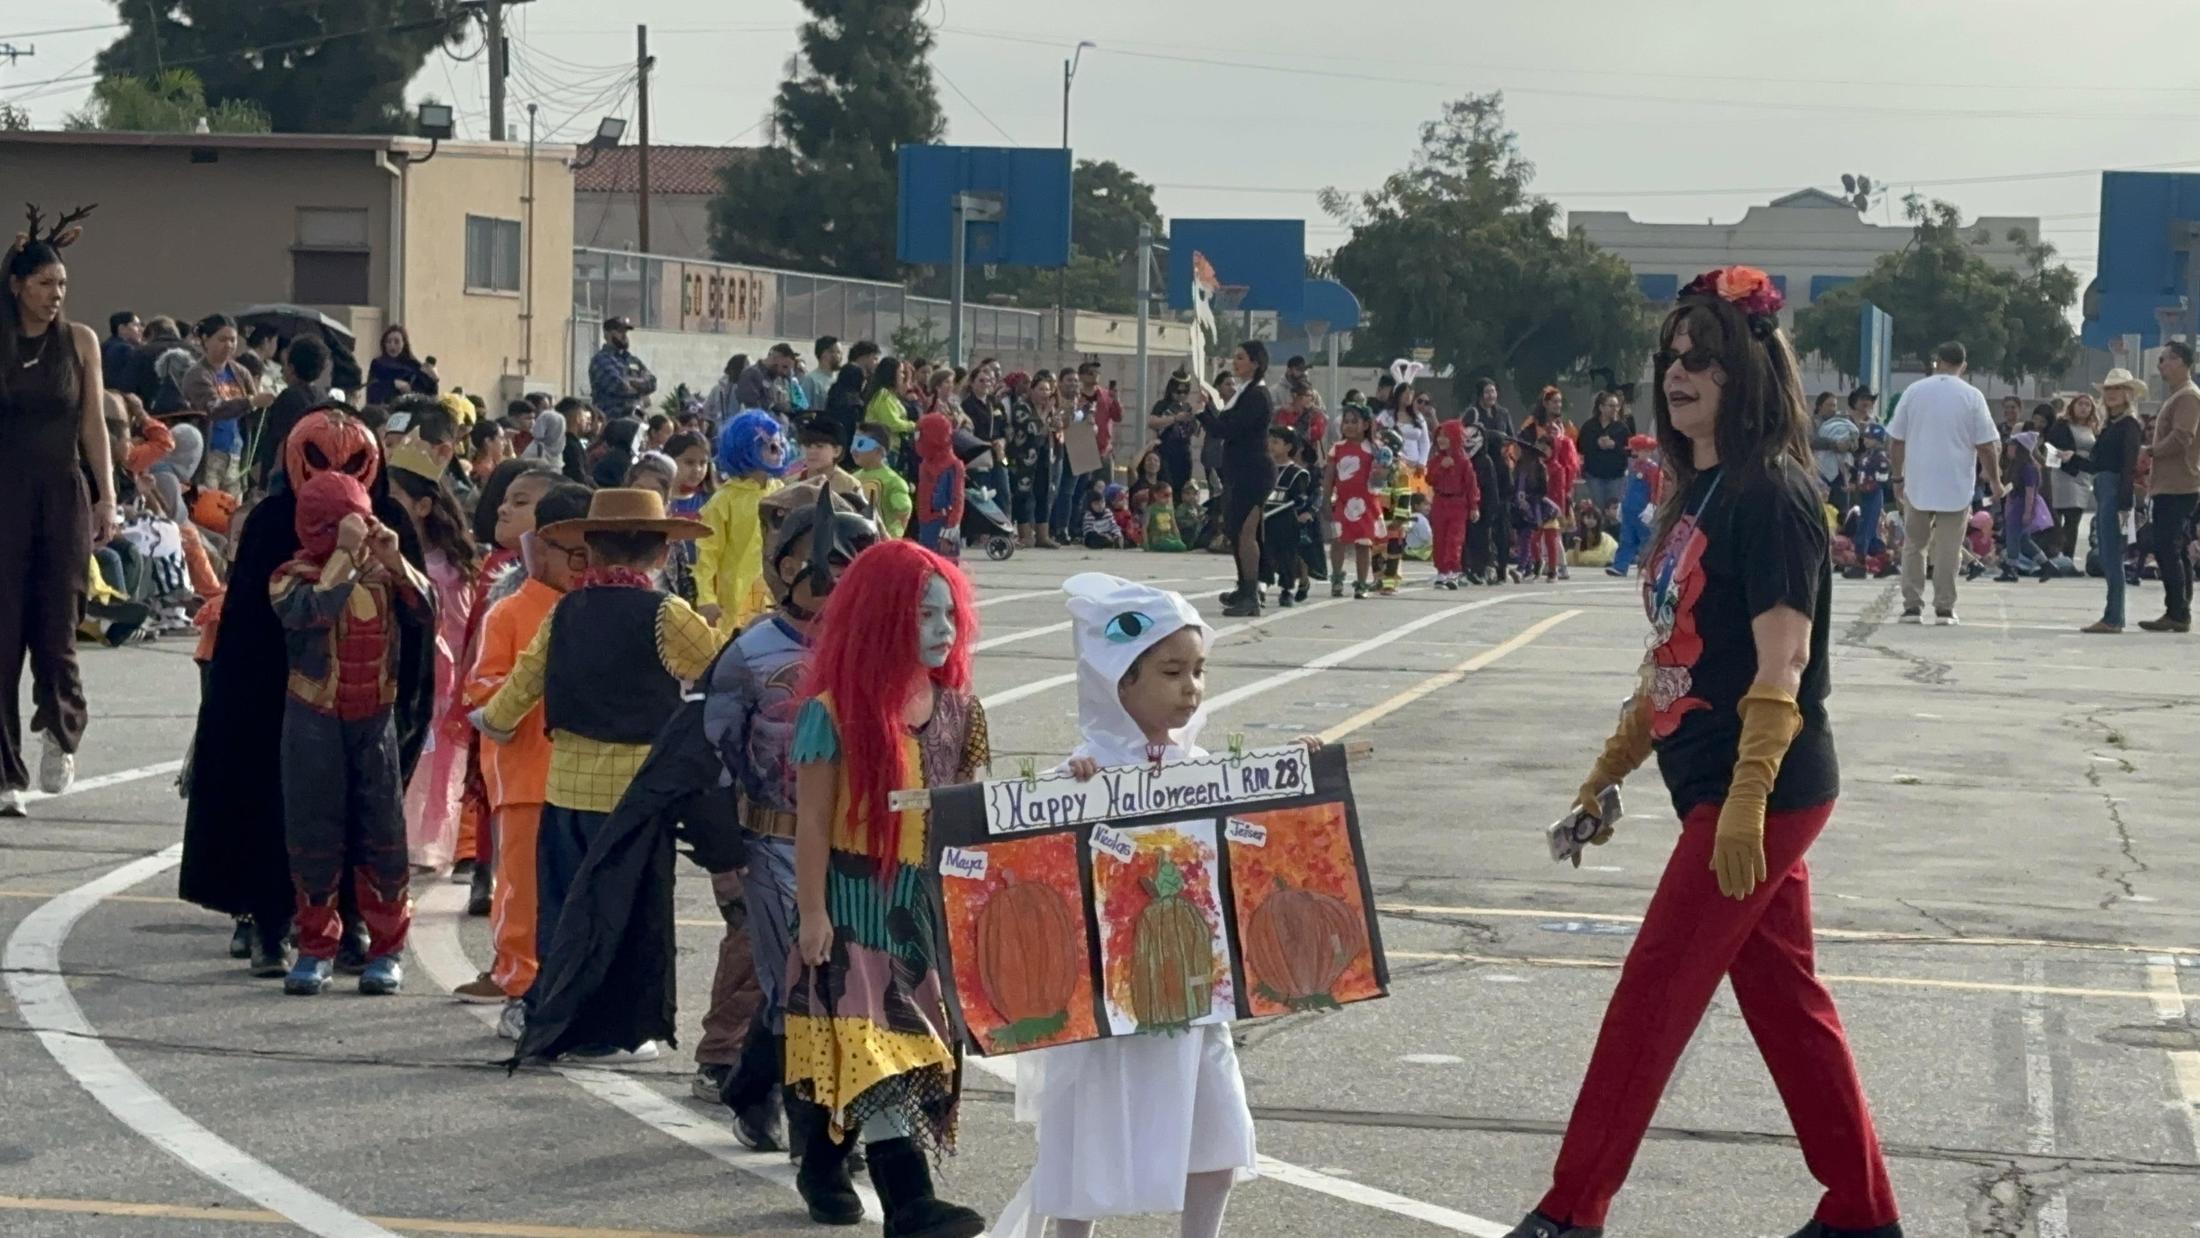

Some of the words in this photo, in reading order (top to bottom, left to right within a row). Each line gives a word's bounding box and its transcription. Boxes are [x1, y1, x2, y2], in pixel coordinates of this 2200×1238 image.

[684, 273, 702, 316] GO
[1005, 783, 1087, 829] Happy
[1102, 763, 1232, 818] Halloween!
[1274, 758, 1300, 790] 28
[1094, 826, 1131, 856] Nicolas
[945, 848, 984, 877] Maya
